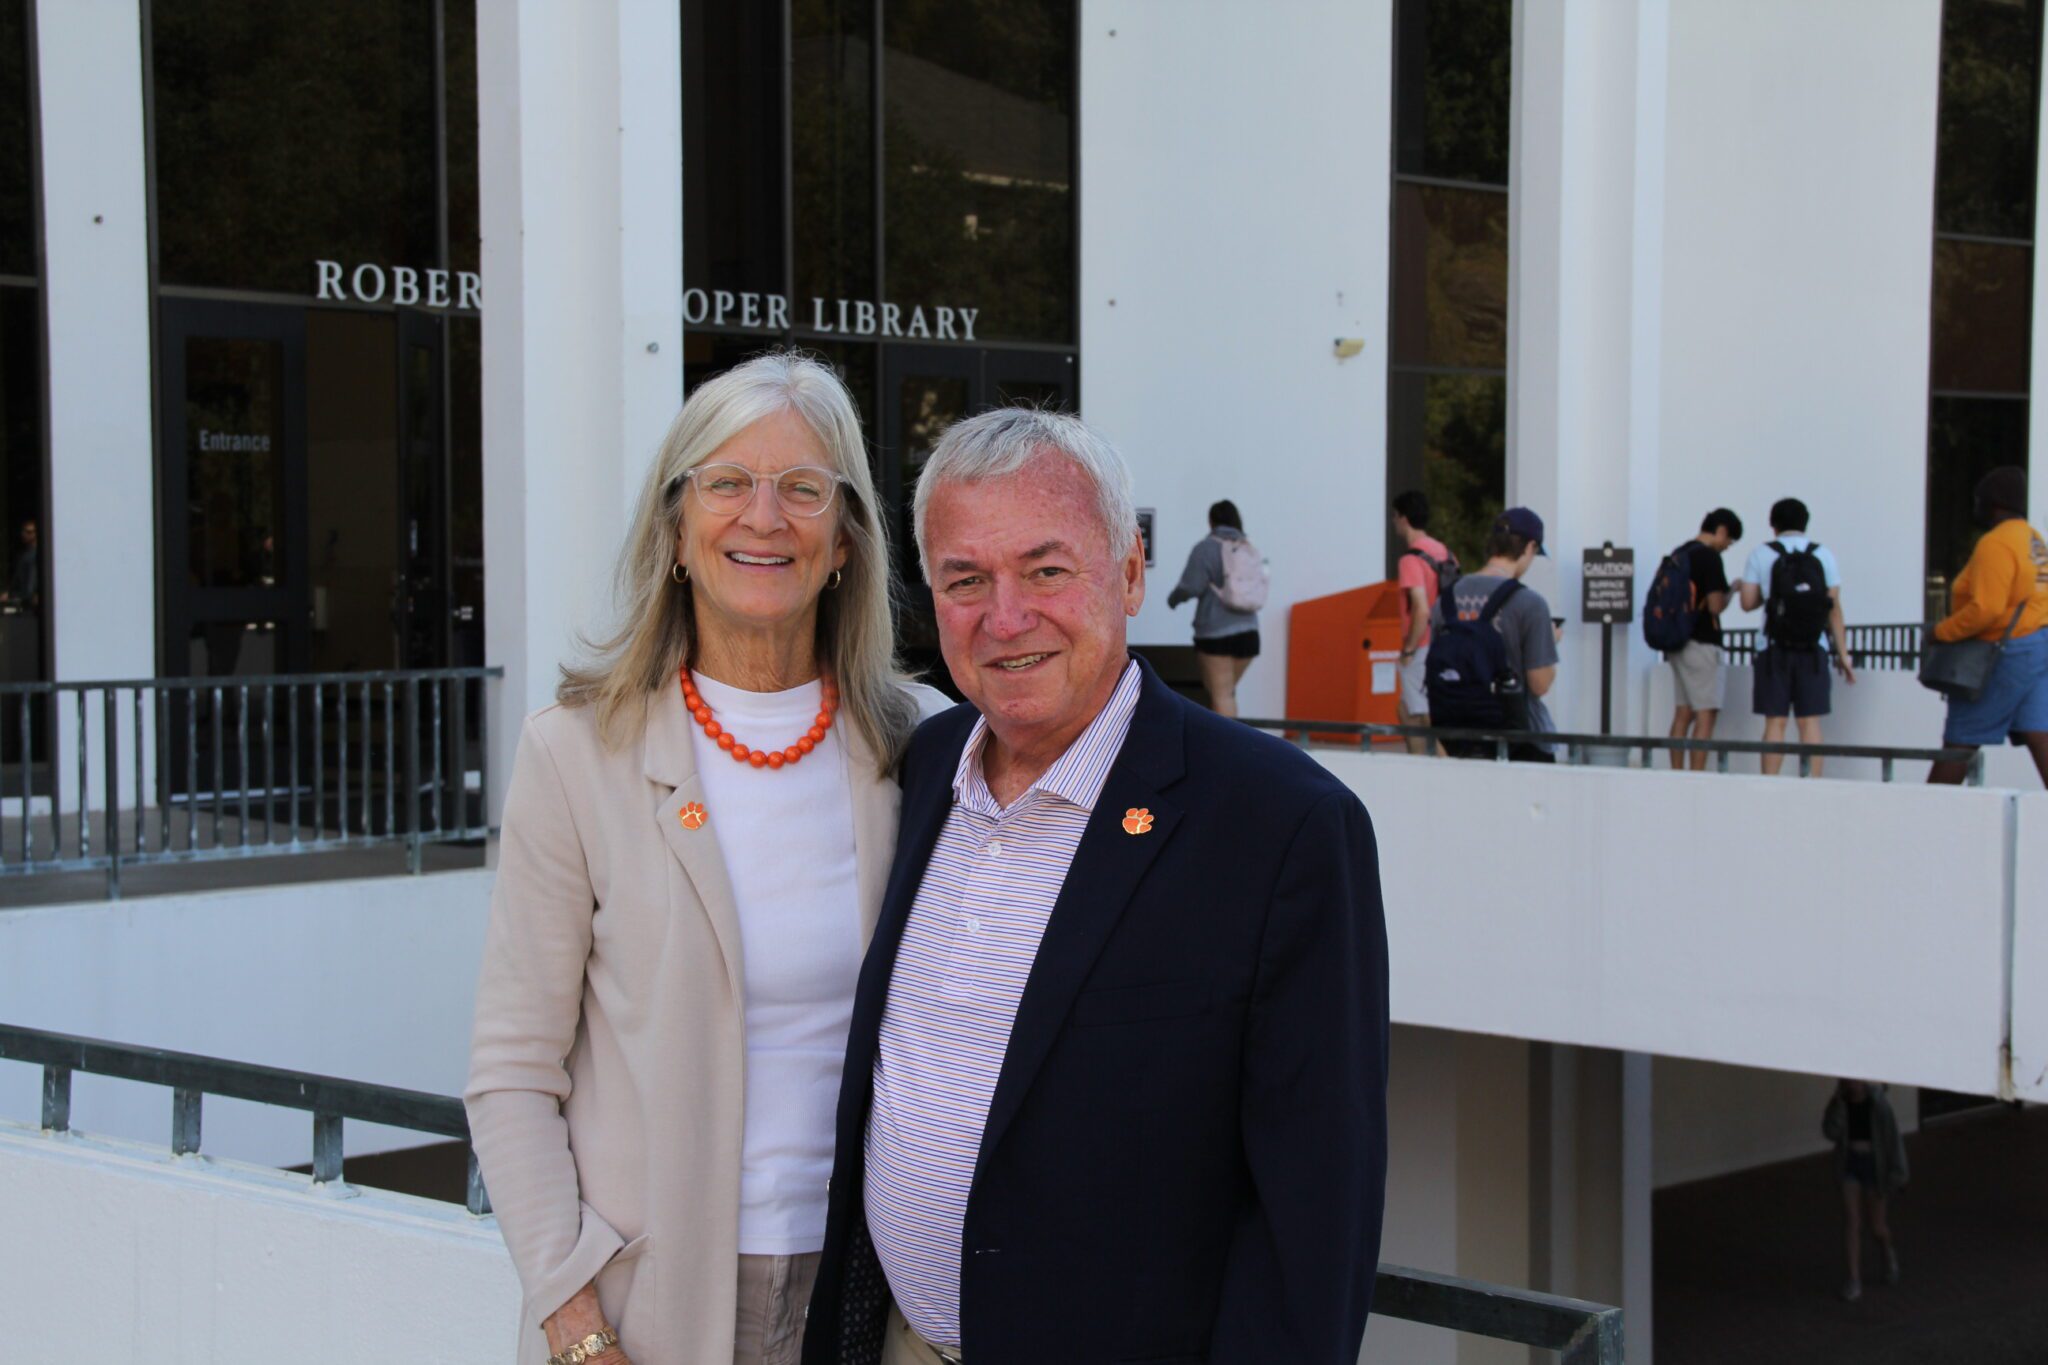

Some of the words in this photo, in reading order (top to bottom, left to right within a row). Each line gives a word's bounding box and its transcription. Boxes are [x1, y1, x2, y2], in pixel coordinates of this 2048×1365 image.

[316, 259, 482, 310] ROBER
[683, 287, 791, 330] OPER
[812, 297, 979, 341] LIBRARY
[199, 429, 271, 452] Entrance
[1584, 562, 1633, 576] CAUTION
